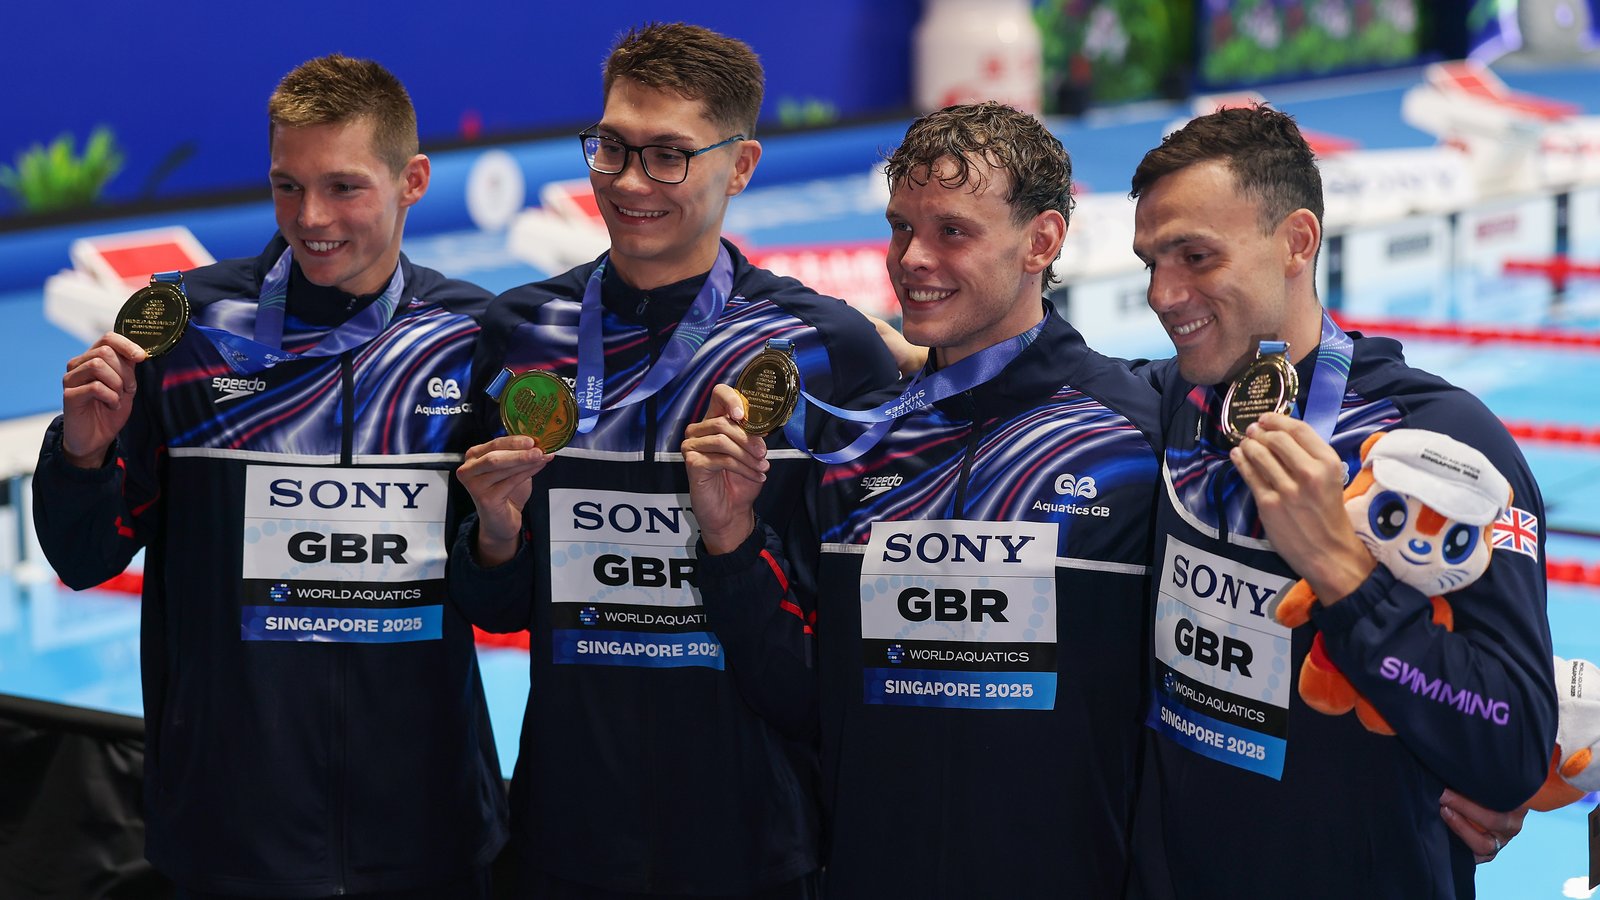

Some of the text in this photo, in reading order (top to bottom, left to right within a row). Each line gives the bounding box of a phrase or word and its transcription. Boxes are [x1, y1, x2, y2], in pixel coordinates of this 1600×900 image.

[212, 377, 266, 392] speedo
[585, 375, 596, 410] SHAP
[577, 391, 586, 404] US
[884, 389, 926, 416] SHAPES
[900, 391, 911, 403] US
[414, 403, 461, 416] Aquatics
[890, 399, 926, 419] WATER
[860, 473, 903, 489] speedo
[269, 478, 429, 509] SONY
[573, 501, 701, 533] SON
[1032, 500, 1110, 517] Aquatics GB
[287, 531, 408, 565] GBR
[882, 532, 1035, 564] SONY
[297, 587, 421, 601] WORLD AQUATICS
[1172, 554, 1276, 618] SONY
[897, 587, 1010, 623] GBR
[265, 617, 422, 632] SINGAPORE 2025
[604, 612, 706, 626] WORLD AQUATI
[577, 640, 720, 657] SINGAPORE 202
[909, 649, 1030, 663] WORLD AQUATICS
[1174, 617, 1254, 678] GBR
[885, 679, 1034, 698] SINGAPORE 2025
[1175, 680, 1265, 723] WORLD AQUATICS
[1161, 706, 1265, 761] SINGAPORE 2025
